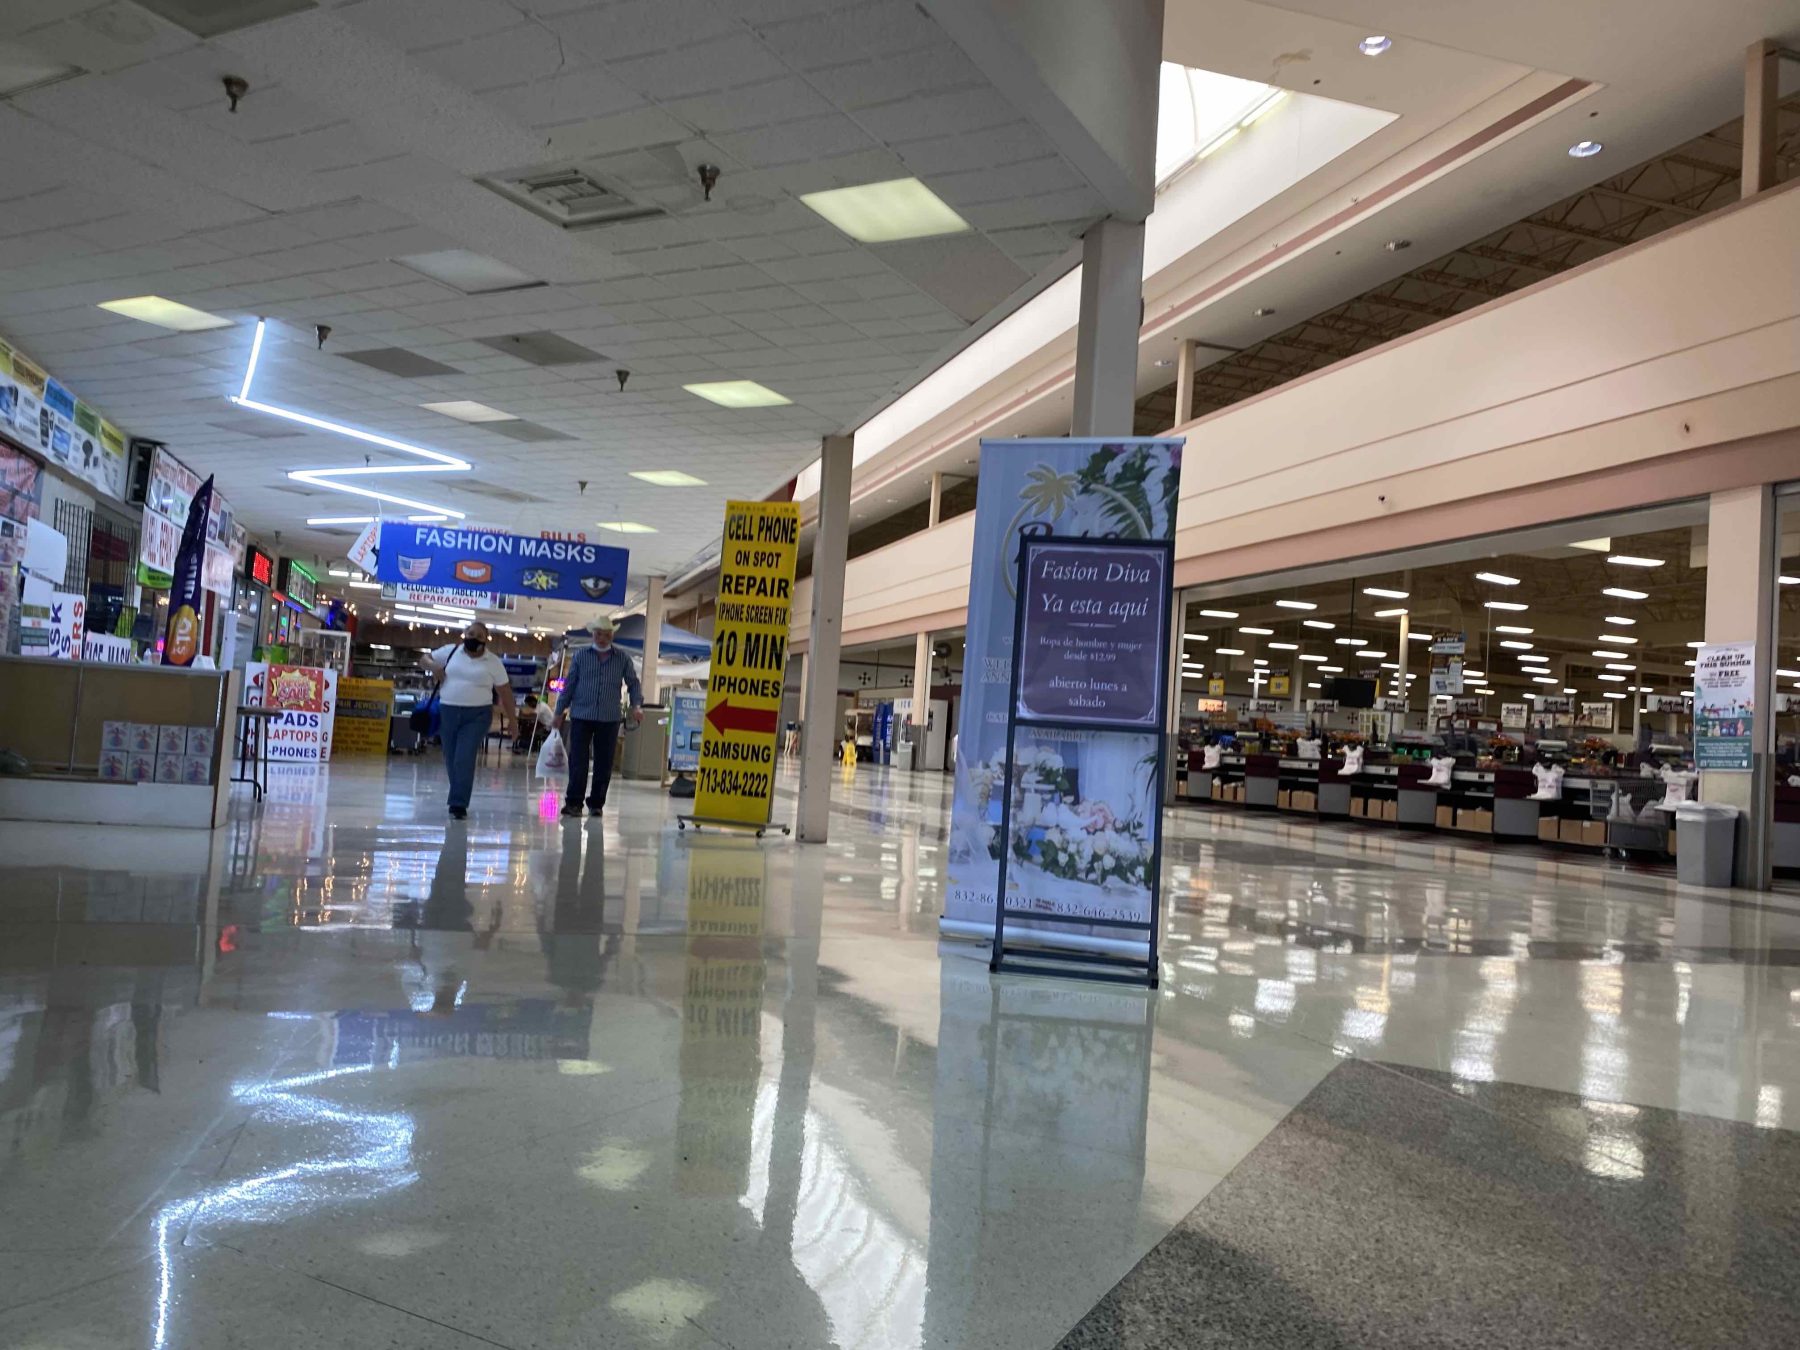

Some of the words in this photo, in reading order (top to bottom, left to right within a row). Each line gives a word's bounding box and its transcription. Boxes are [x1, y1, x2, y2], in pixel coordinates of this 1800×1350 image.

[540, 529, 587, 544] BILLS
[728, 513, 754, 542] CELL
[757, 515, 798, 544] PHONE
[415, 527, 513, 555] FASHION
[518, 538, 597, 564] MASKS
[735, 550, 750, 568] ON
[753, 551, 782, 569] SPOT
[1041, 560, 1098, 582] Fasion
[1105, 562, 1151, 583] Diva
[721, 573, 790, 599] REPAIR
[409, 592, 478, 607] REPARACION
[1041, 593, 1064, 614] Ya
[1070, 598, 1103, 615] esta
[1108, 597, 1149, 623] aqui
[719, 602, 745, 622] IPHONE
[745, 604, 773, 625] SCREEN
[774, 607, 788, 626] FIX
[715, 629, 738, 667] 10
[744, 632, 786, 671] MIN
[1039, 636, 1061, 649] Ropa
[1063, 637, 1074, 647] de
[1075, 637, 1107, 649] hombre
[1109, 641, 1115, 650] y
[1117, 641, 1143, 652] mujer
[1063, 651, 1087, 661] desde
[1090, 652, 1116, 662] $12.99
[712, 675, 781, 698] IPHONES
[1049, 676, 1087, 690] abierto
[1090, 677, 1119, 692] lunes
[1121, 684, 1128, 692] a
[1068, 695, 1106, 708] sabado
[267, 728, 318, 742] LAPTOPS
[703, 740, 771, 763] SAMSUNG
[700, 767, 768, 798] 713-834-2222
